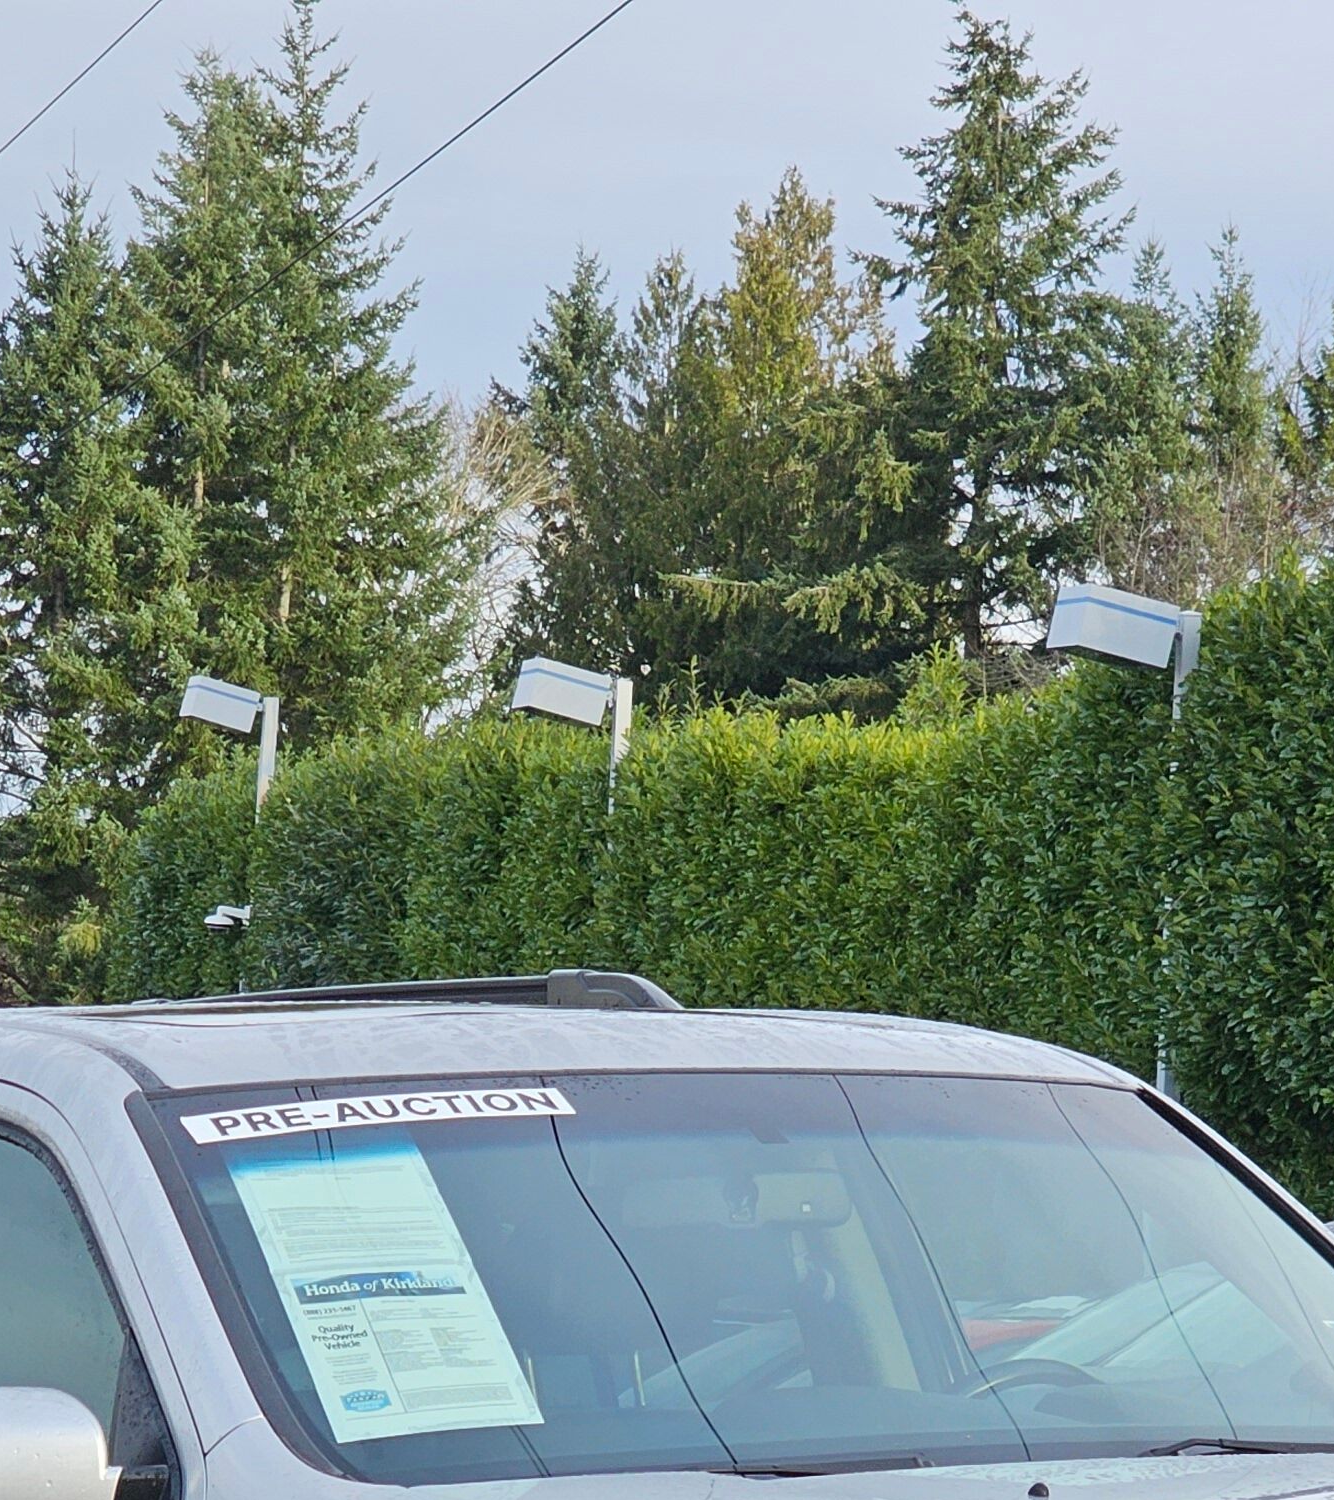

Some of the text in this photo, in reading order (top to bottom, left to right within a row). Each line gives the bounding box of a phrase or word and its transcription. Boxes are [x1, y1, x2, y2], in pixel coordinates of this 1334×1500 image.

[210, 1091, 560, 1137] PRE-AUCTION
[304, 1277, 457, 1297] Honda of Kirkland
[318, 1324, 354, 1334] Quality
[311, 1330, 368, 1342] Pre-Owned
[324, 1340, 361, 1350] Vehicle
